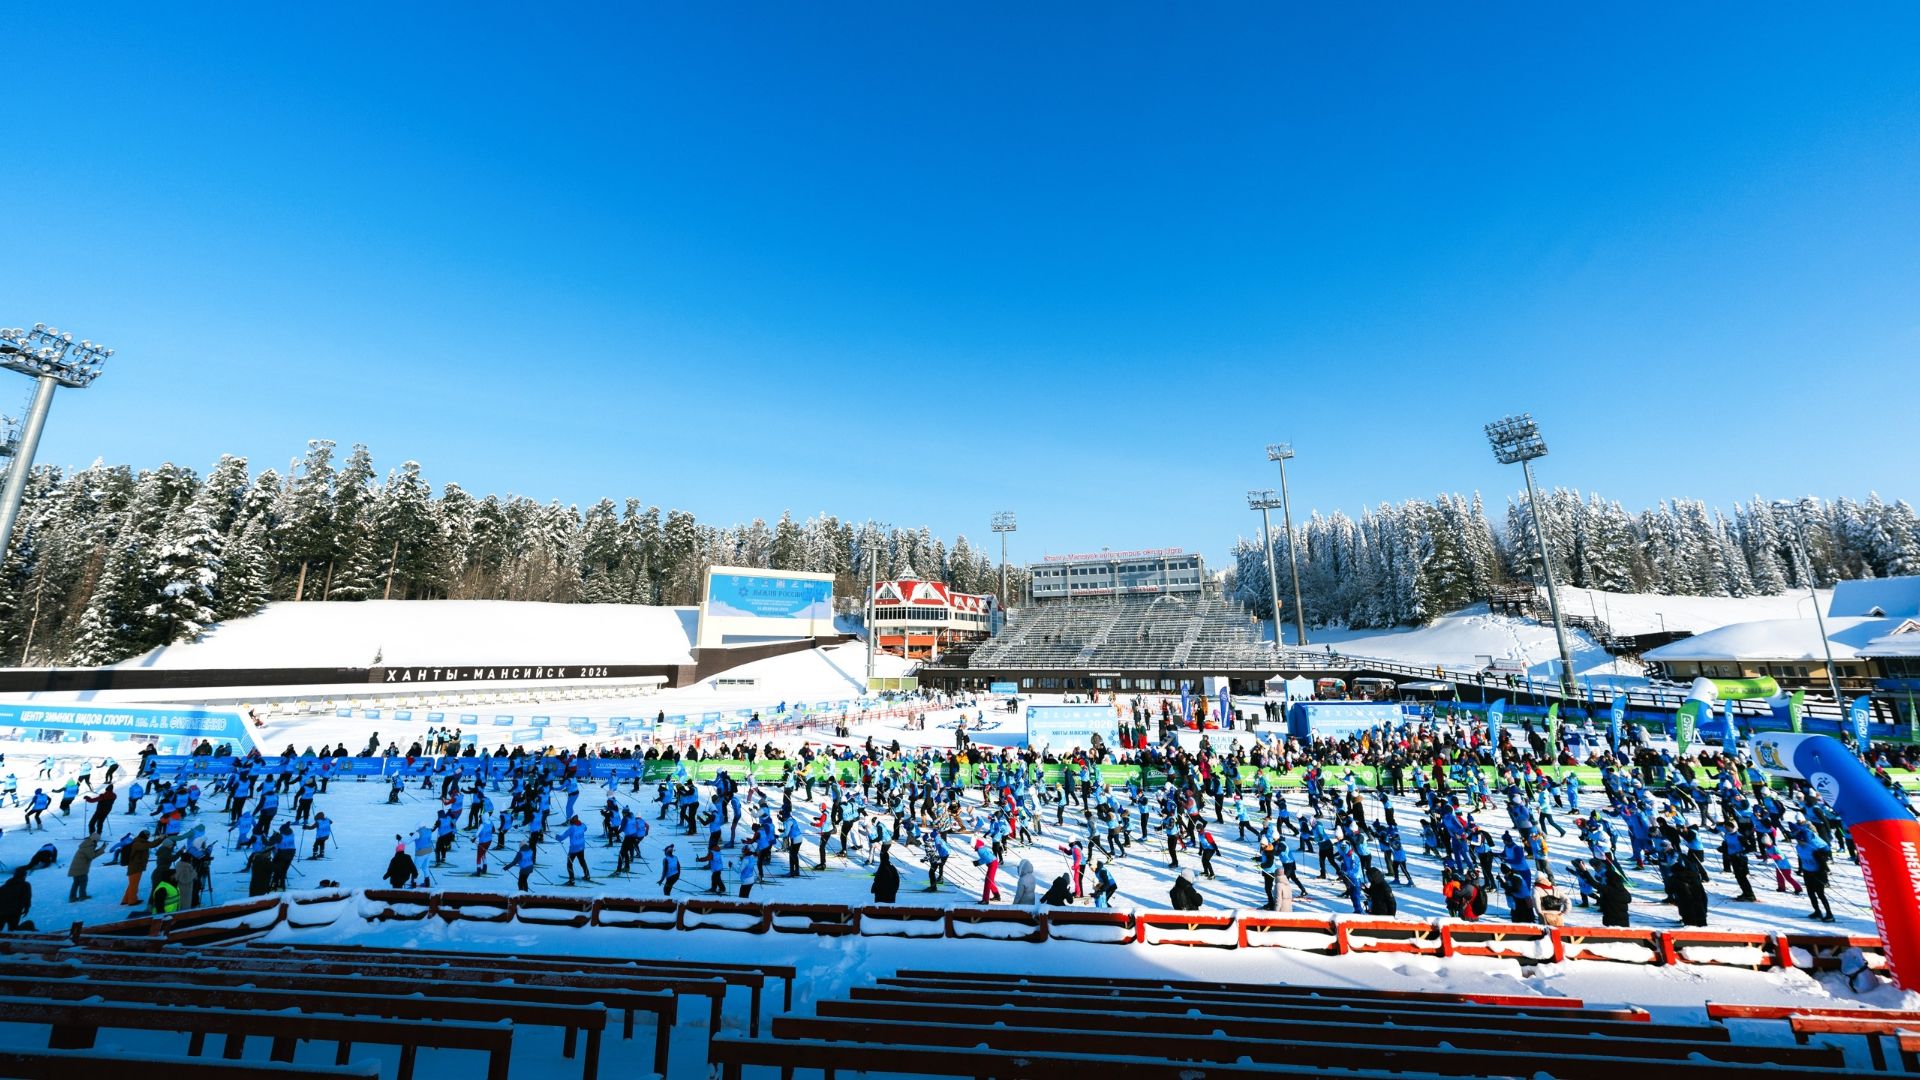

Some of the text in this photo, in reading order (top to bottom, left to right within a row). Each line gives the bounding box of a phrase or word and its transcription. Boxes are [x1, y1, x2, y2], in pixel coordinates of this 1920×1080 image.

[386, 666, 608, 682] ХАНТЫ-МАНСИЙСК 2026
[21, 710, 44, 722] ЦЕНТР
[44, 711, 75, 722] ЗИМНИХ
[75, 713, 103, 726] ВИДОВ
[102, 714, 134, 726] СПОРТА
[1901, 841, 1920, 894] ЖИЗНИ
